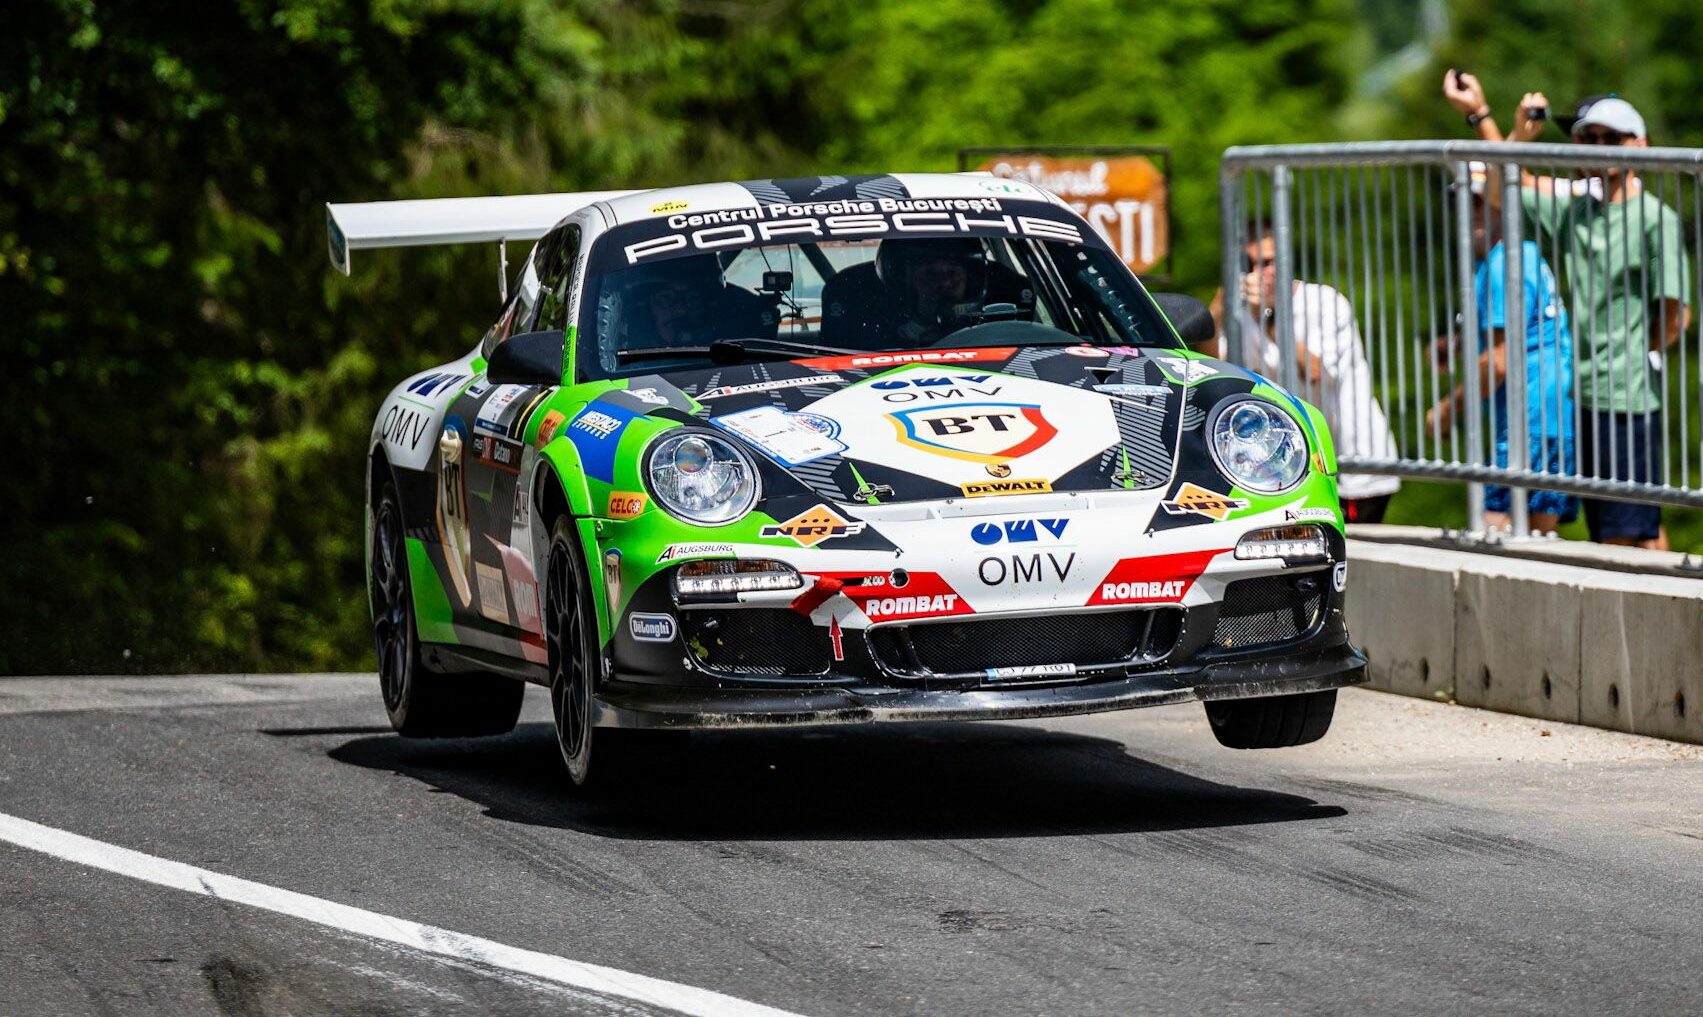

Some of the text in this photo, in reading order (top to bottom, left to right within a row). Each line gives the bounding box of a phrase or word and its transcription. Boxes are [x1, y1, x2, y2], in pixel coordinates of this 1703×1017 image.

[667, 197, 1003, 230] Centrul Porsche București
[623, 212, 1084, 265] PORSCHE
[851, 351, 979, 366] ROMBAT
[882, 386, 1003, 403] OMV
[382, 404, 431, 451] OMV
[922, 413, 1017, 436] BT
[610, 498, 641, 515] CELCO
[1163, 499, 1248, 512] NRF
[761, 523, 862, 537] NRF
[676, 544, 734, 555] AUGSBURG
[607, 564, 618, 585] BT
[978, 552, 1076, 586] OMV
[1101, 580, 1186, 600] ROMBAT
[866, 593, 958, 616] ROMBAT
